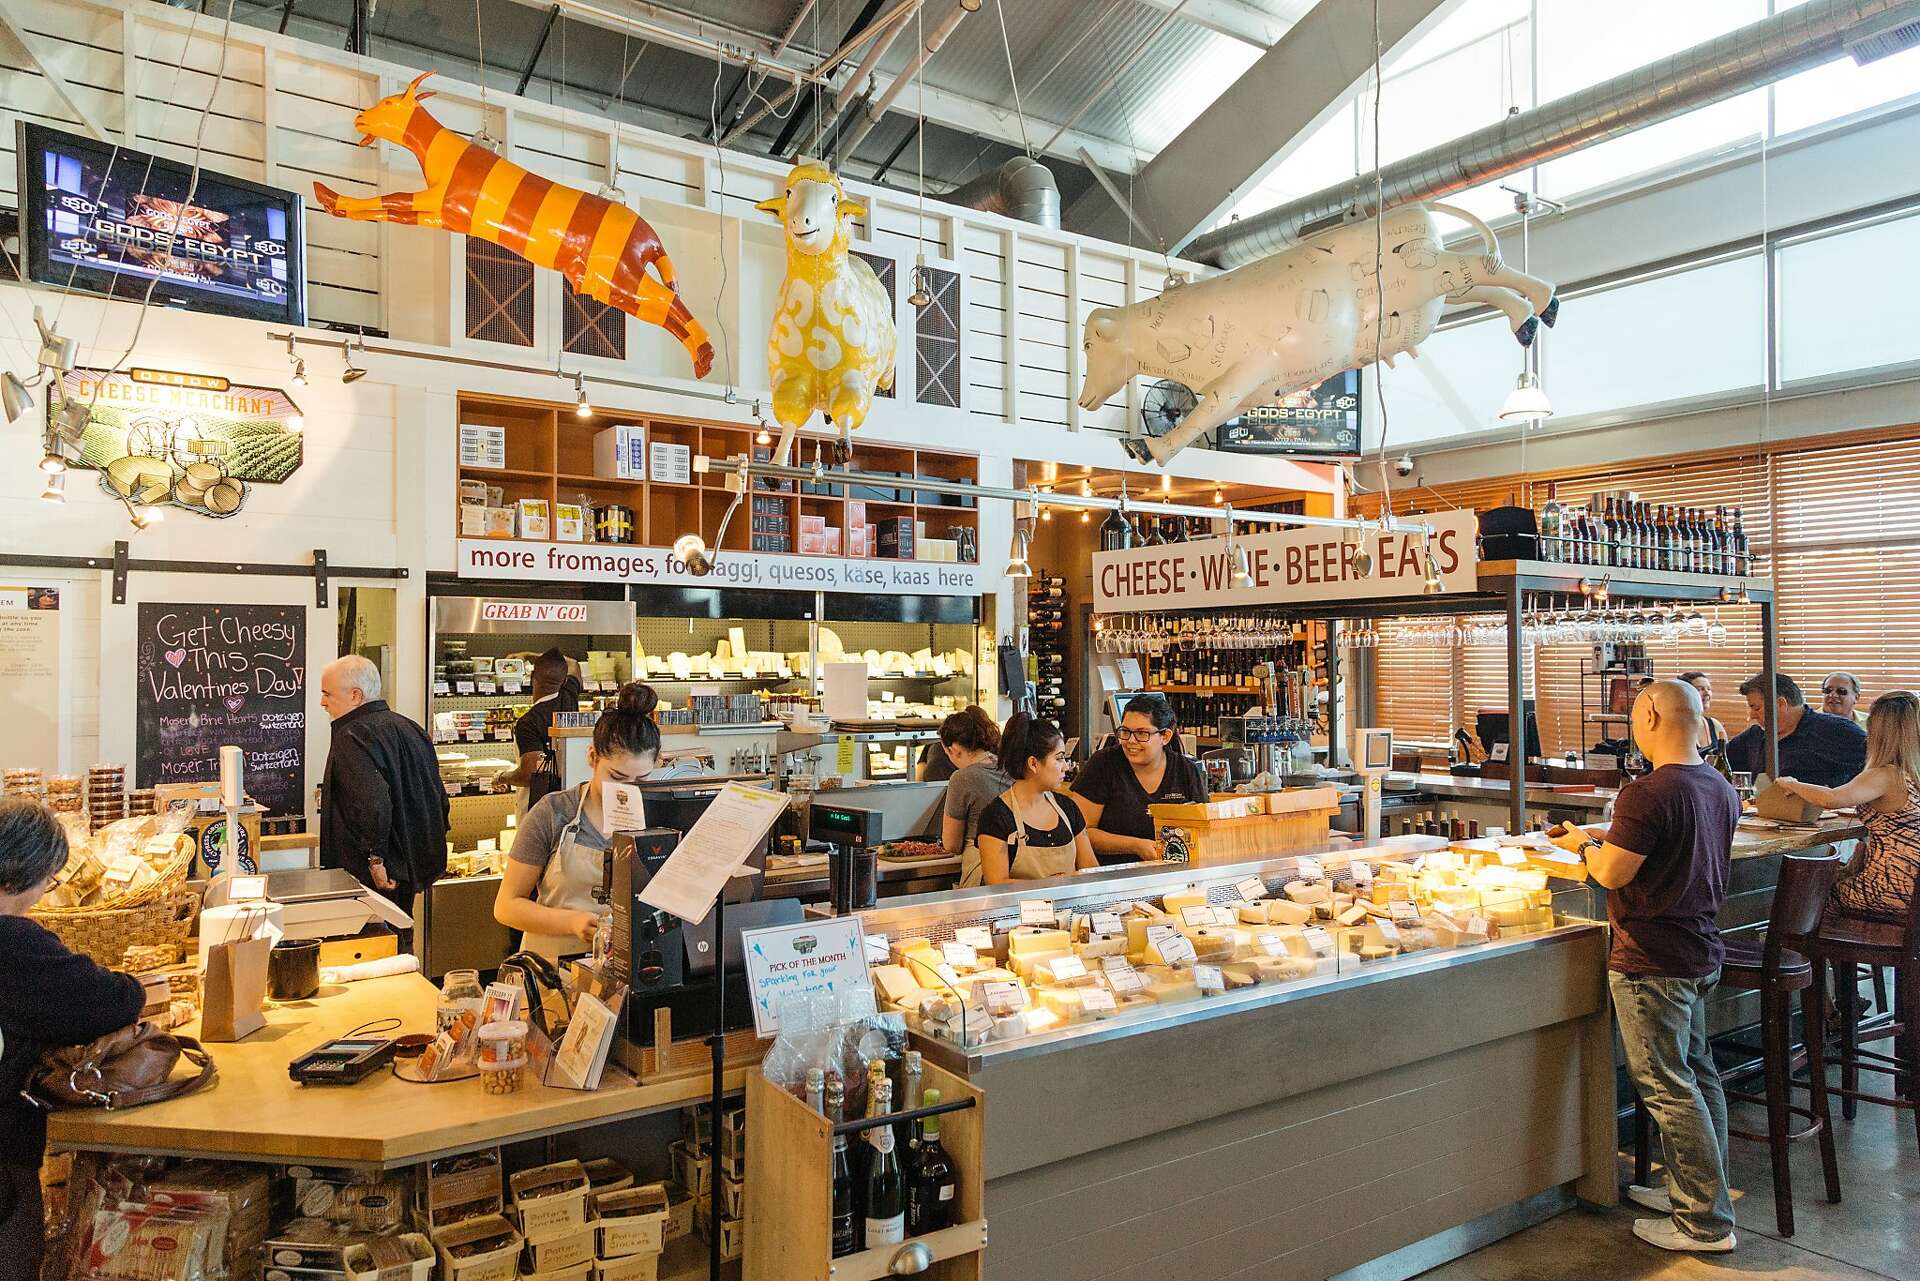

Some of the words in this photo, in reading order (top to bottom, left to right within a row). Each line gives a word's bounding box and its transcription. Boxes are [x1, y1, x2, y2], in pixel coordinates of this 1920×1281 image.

[95, 219, 172, 244] GODS
[185, 239, 263, 265] EGYPT
[79, 380, 160, 404] CHEESE
[170, 387, 275, 416] MERCHANT
[1247, 407, 1288, 418] GODS
[1296, 408, 1342, 419] EGYPT
[471, 548, 535, 568] more
[547, 548, 659, 577] fromages,
[666, 553, 762, 584] foaggi,
[769, 566, 837, 587] quesos,
[844, 564, 887, 588] käse,
[892, 567, 930, 586] kaas
[938, 568, 974, 587] here
[1101, 558, 1186, 598] CHEESE
[1199, 548, 1269, 591] WIE
[1378, 530, 1459, 578] EAS
[484, 604, 531, 619] GRAB
[536, 605, 555, 620] N'
[556, 606, 586, 620] GO!
[156, 613, 213, 648] Get
[219, 617, 295, 660] Cheesy
[188, 647, 248, 673] This
[149, 669, 249, 703] Valentines
[255, 667, 304, 698] Day!
[200, 714, 223, 726] Brie
[180, 746, 209, 756] LOVE
[769, 961, 787, 973] PICK
[788, 960, 800, 969] OF
[802, 957, 817, 967] THE
[818, 952, 847, 963] MONTH
